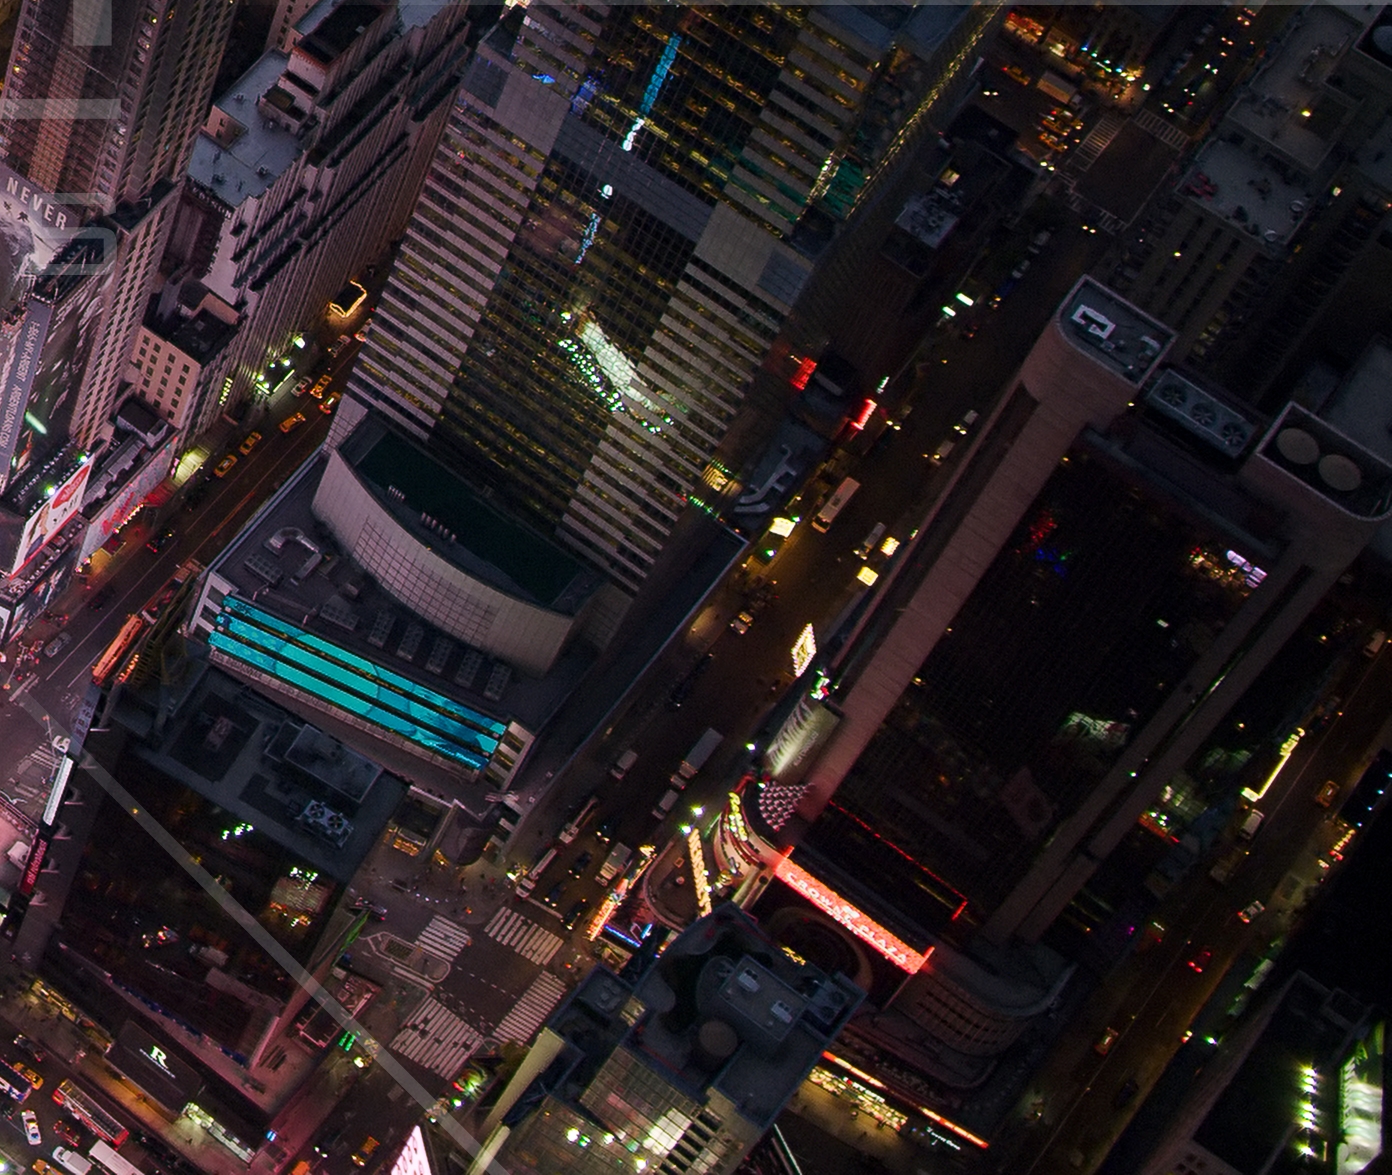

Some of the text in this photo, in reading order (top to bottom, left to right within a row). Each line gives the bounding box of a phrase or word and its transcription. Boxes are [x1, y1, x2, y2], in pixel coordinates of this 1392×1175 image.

[5, 175, 68, 232] NEVER
[787, 872, 853, 922] CROWNE
[860, 924, 907, 965] PLAZA
[149, 1045, 169, 1069] R
